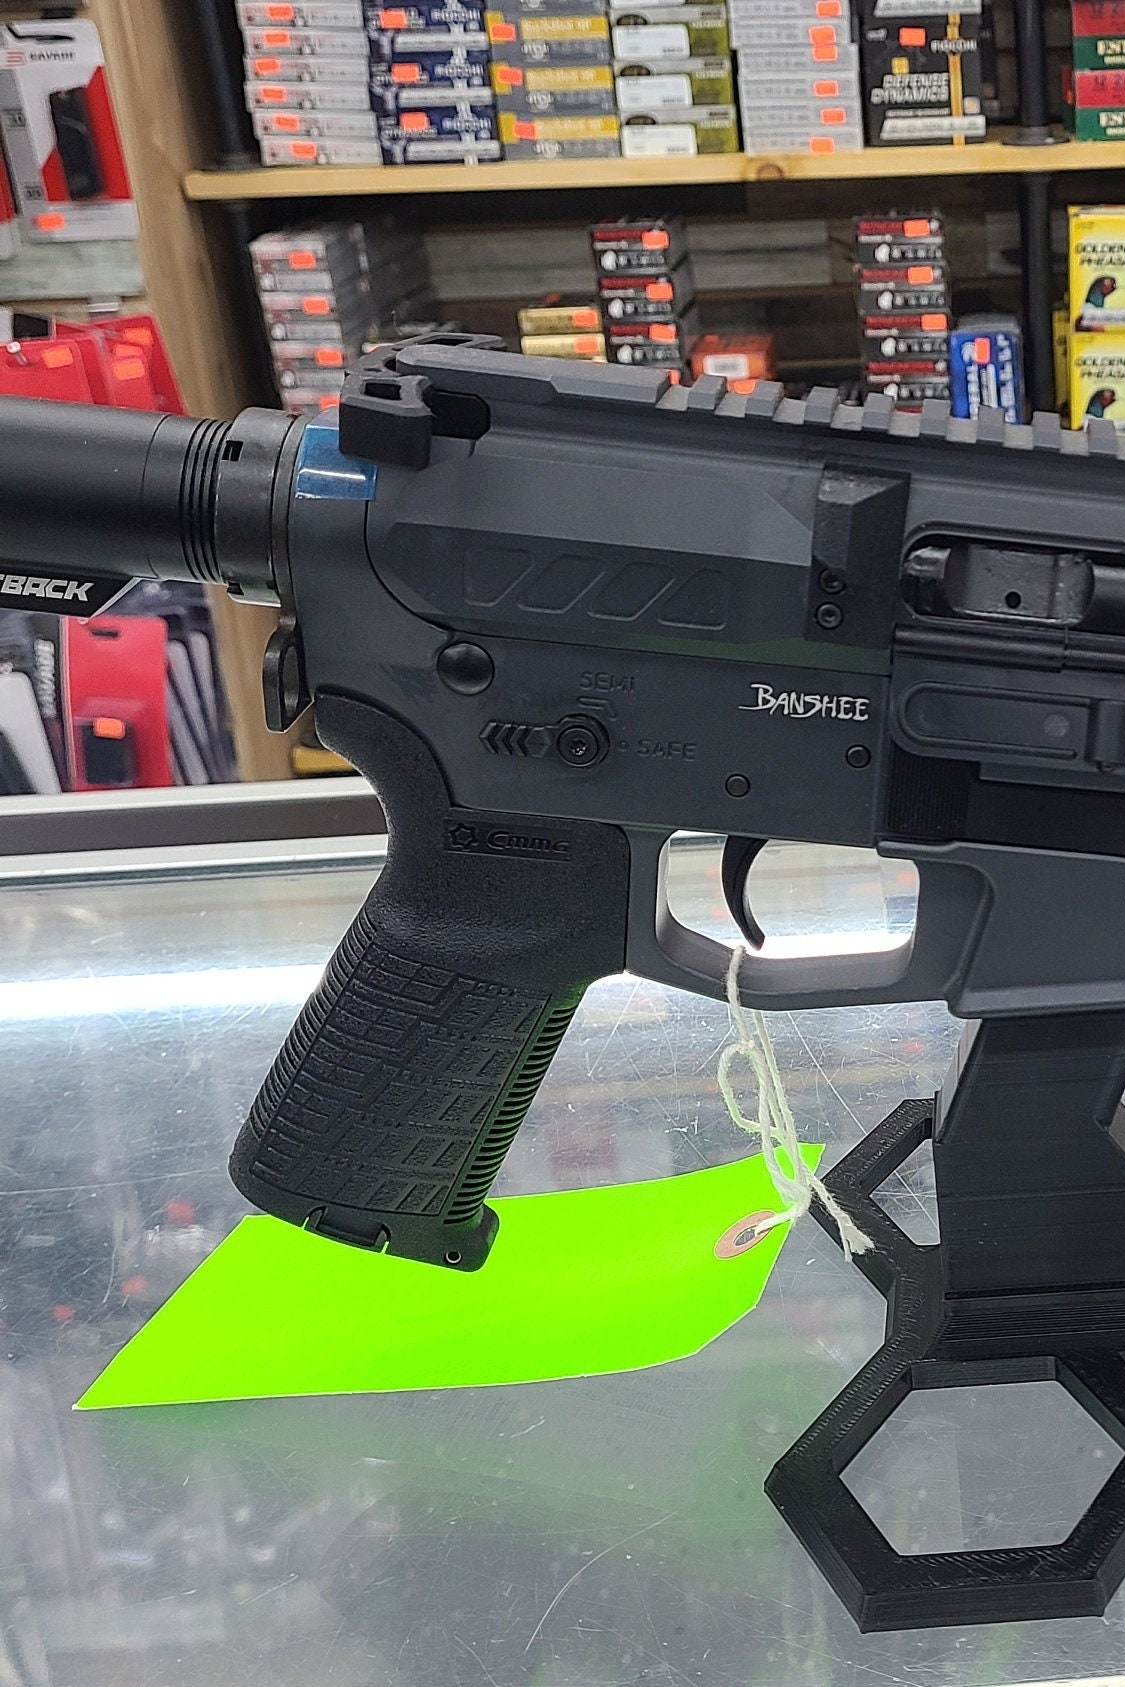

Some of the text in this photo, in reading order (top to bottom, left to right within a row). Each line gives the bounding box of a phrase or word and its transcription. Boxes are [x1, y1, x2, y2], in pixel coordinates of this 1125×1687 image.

[883, 73, 949, 88] DEFENSE
[871, 86, 949, 104] DYNAMICS
[579, 671, 636, 695] SEMI
[738, 684, 870, 721] BANSHEE
[636, 738, 698, 762] SAFE
